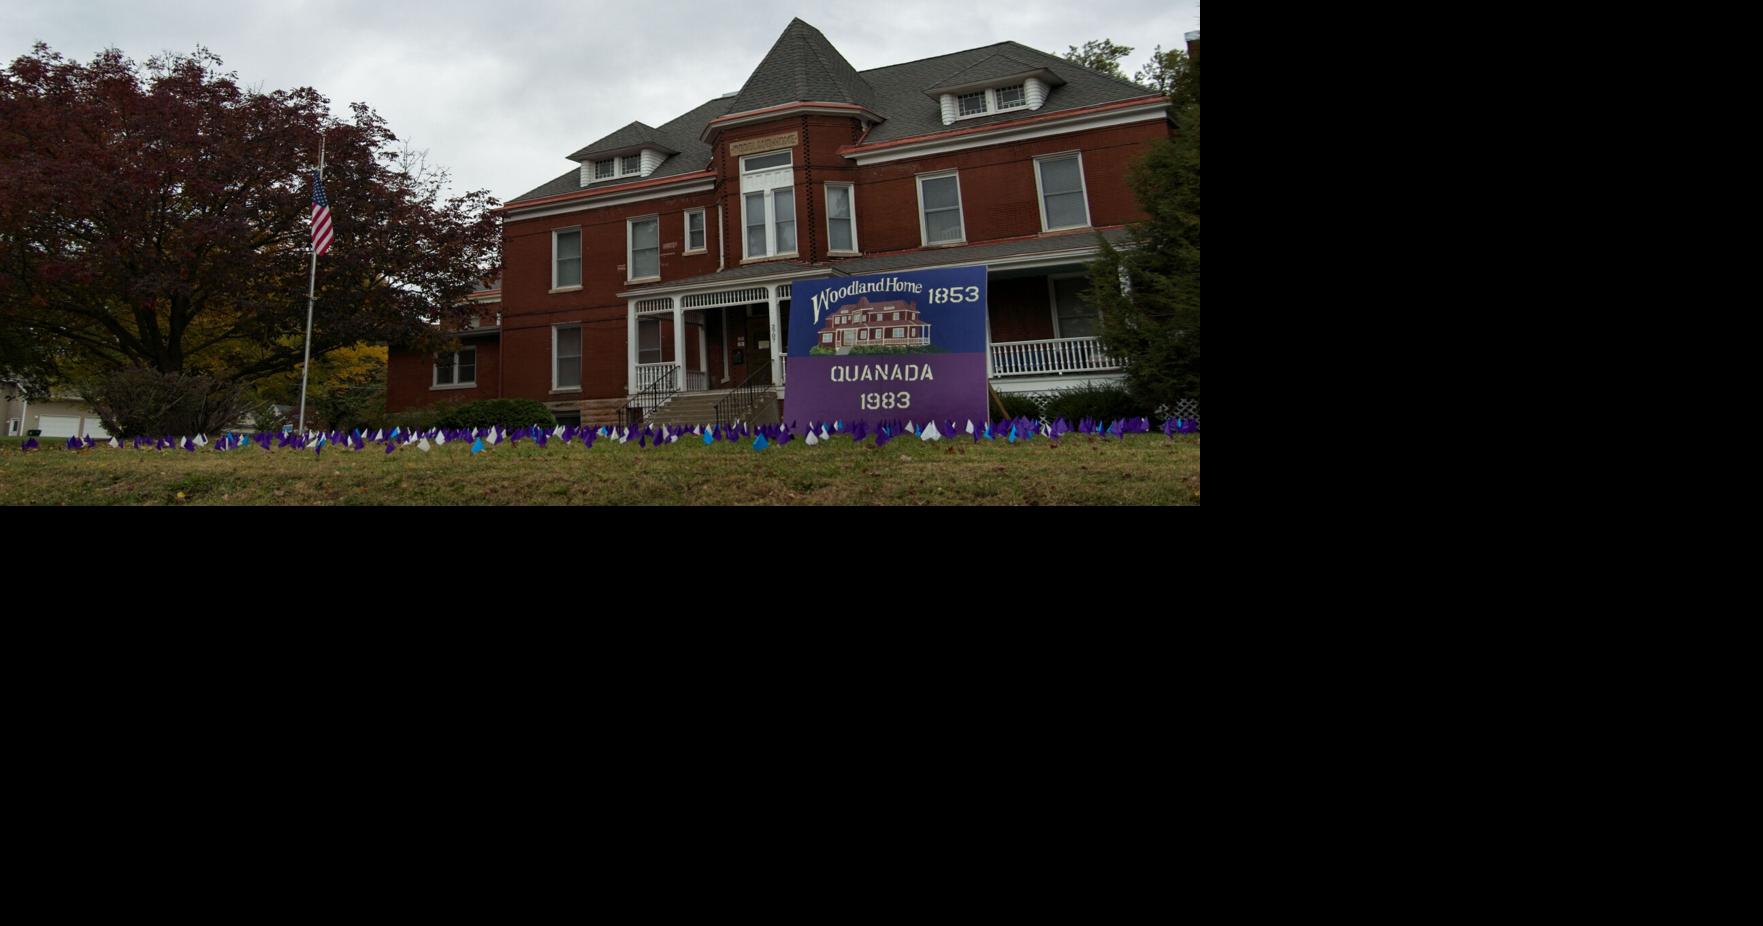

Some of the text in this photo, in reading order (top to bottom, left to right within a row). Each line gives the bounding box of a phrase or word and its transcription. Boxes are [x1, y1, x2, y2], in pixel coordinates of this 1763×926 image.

[811, 277, 923, 325] Woodland Home
[928, 286, 979, 304] 1853
[830, 363, 933, 382] QUANADA
[860, 391, 910, 409] 1983
